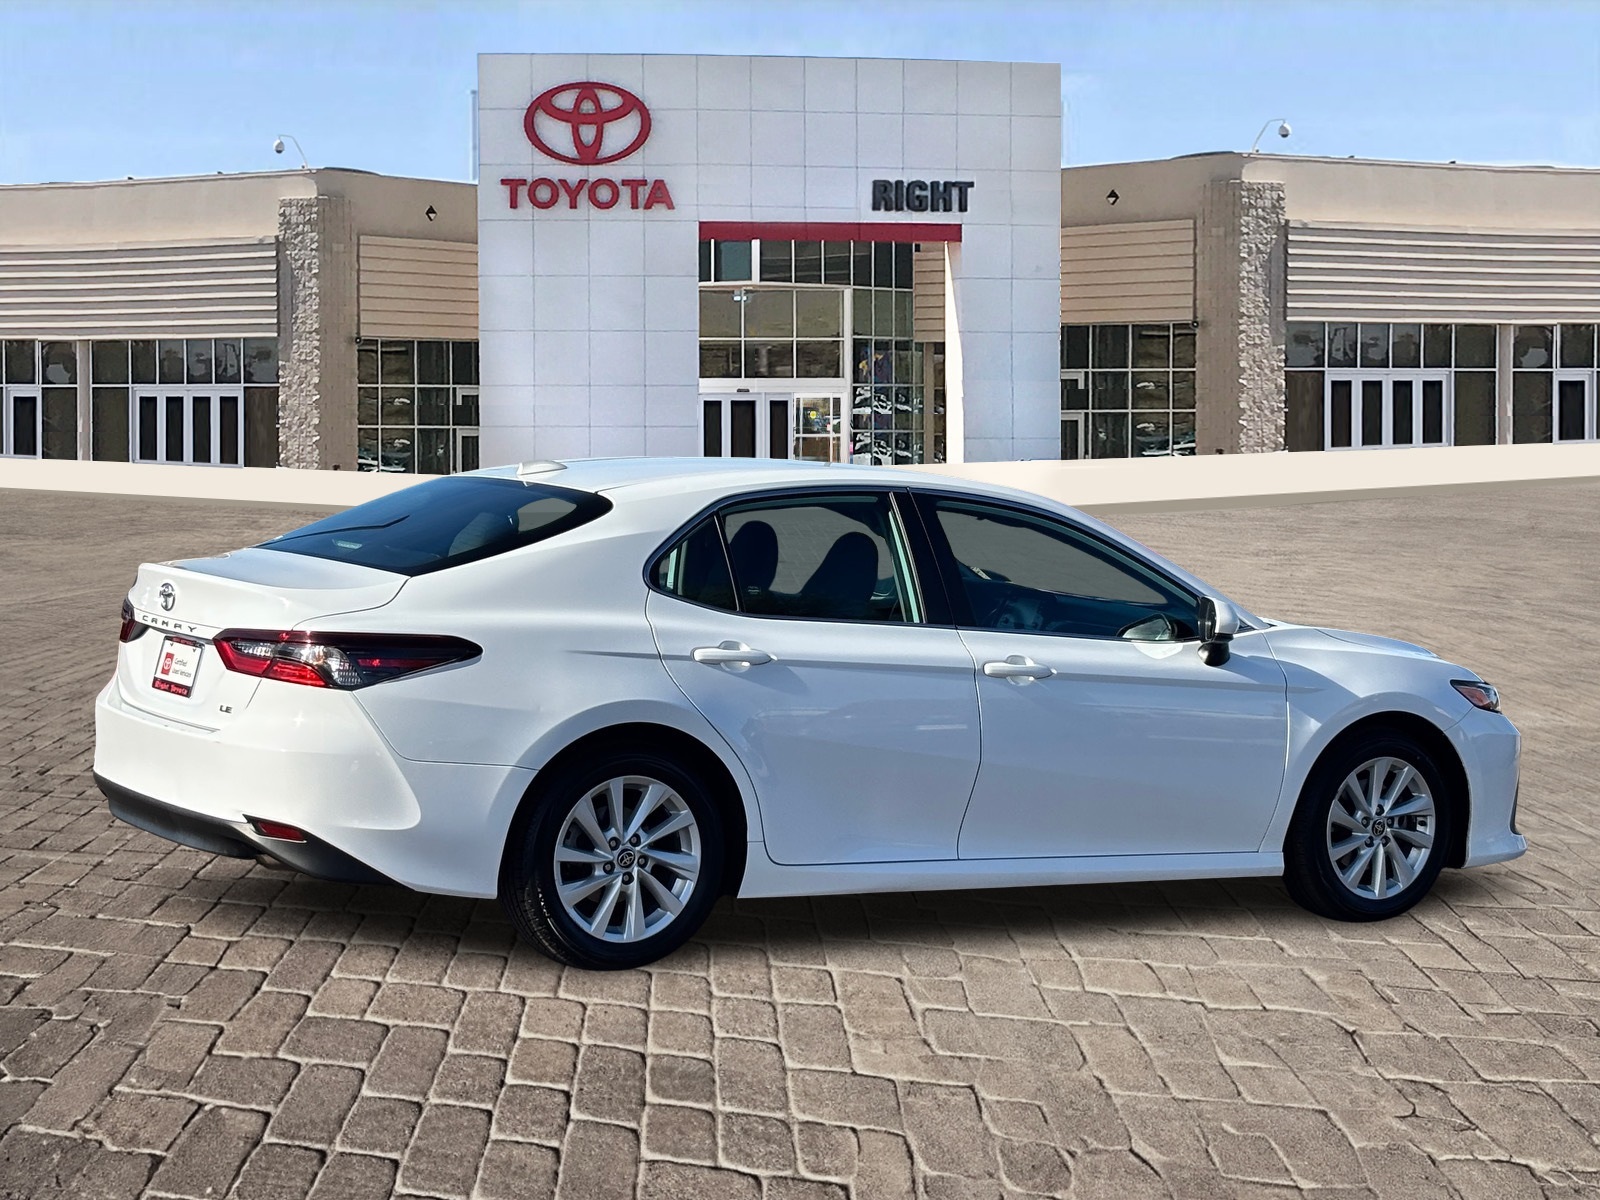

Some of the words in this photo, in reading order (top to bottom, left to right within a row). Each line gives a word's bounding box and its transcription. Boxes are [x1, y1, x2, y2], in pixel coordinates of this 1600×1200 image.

[500, 177, 675, 210] TOYOTA
[872, 179, 975, 212] RIGHT
[142, 615, 197, 632] CAMRY
[219, 705, 232, 713] LE
